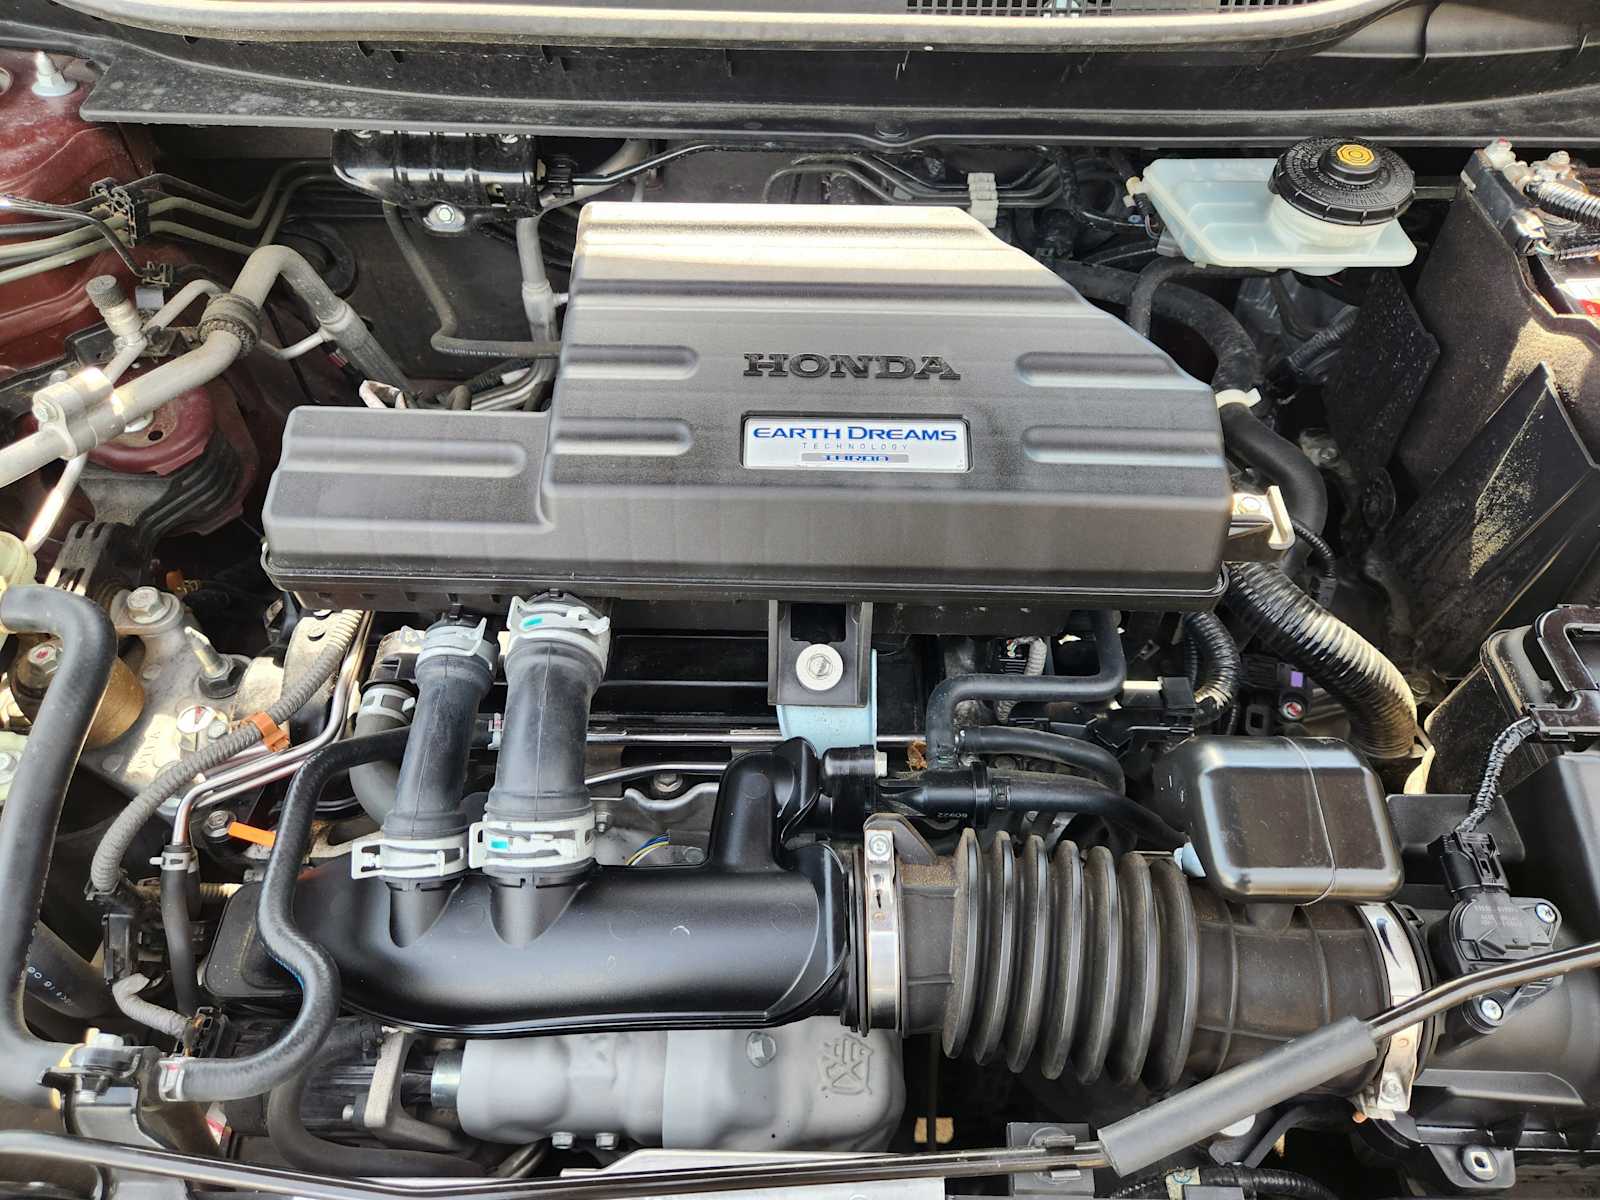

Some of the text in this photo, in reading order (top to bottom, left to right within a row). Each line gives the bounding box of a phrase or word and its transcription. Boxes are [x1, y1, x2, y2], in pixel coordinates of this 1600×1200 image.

[743, 353, 961, 381] HONDA
[753, 426, 957, 441] EARTH DREAMS
[802, 442, 908, 450] TECHNOLOGY
